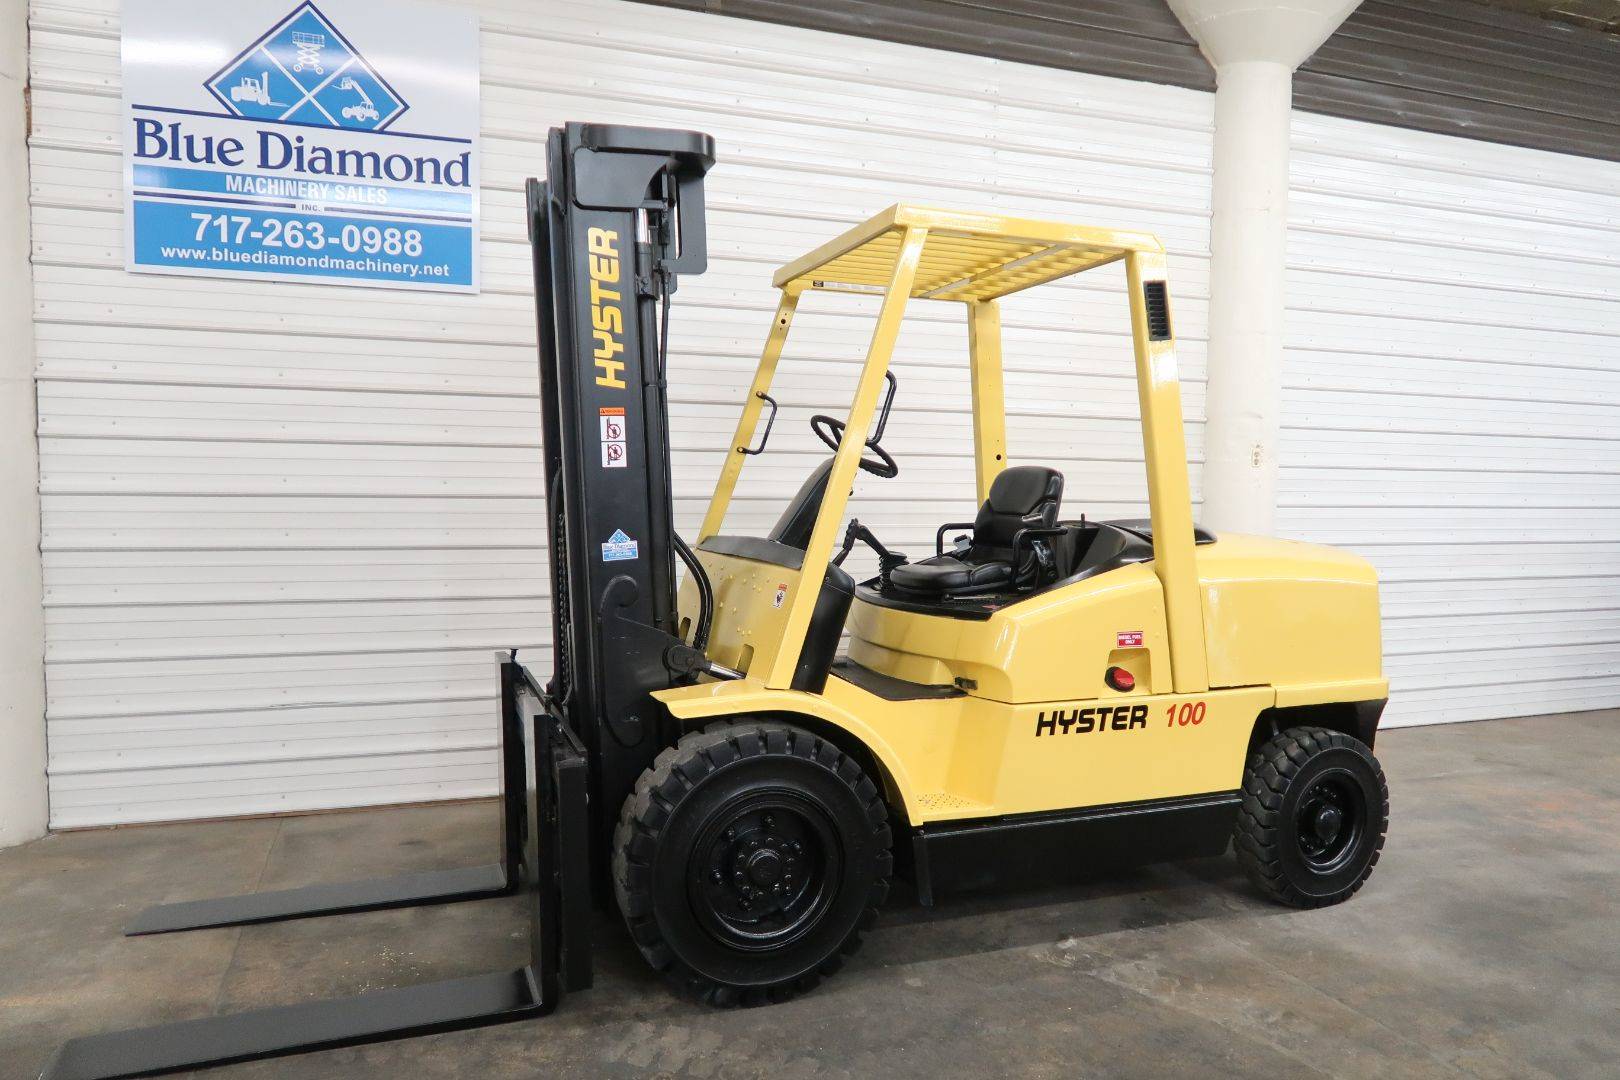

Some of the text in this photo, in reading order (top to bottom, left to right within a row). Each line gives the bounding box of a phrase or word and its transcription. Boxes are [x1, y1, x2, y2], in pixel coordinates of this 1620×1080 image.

[133, 117, 472, 187] Blue Diamond
[225, 174, 388, 205] MACHINERY SALES
[301, 203, 321, 212] INC.
[191, 212, 424, 257] 717-263-0988
[161, 245, 449, 277] www.bluediamondmachinery.net
[587, 226, 626, 389] HYSTER
[1035, 701, 1206, 737] HYSTER 100
